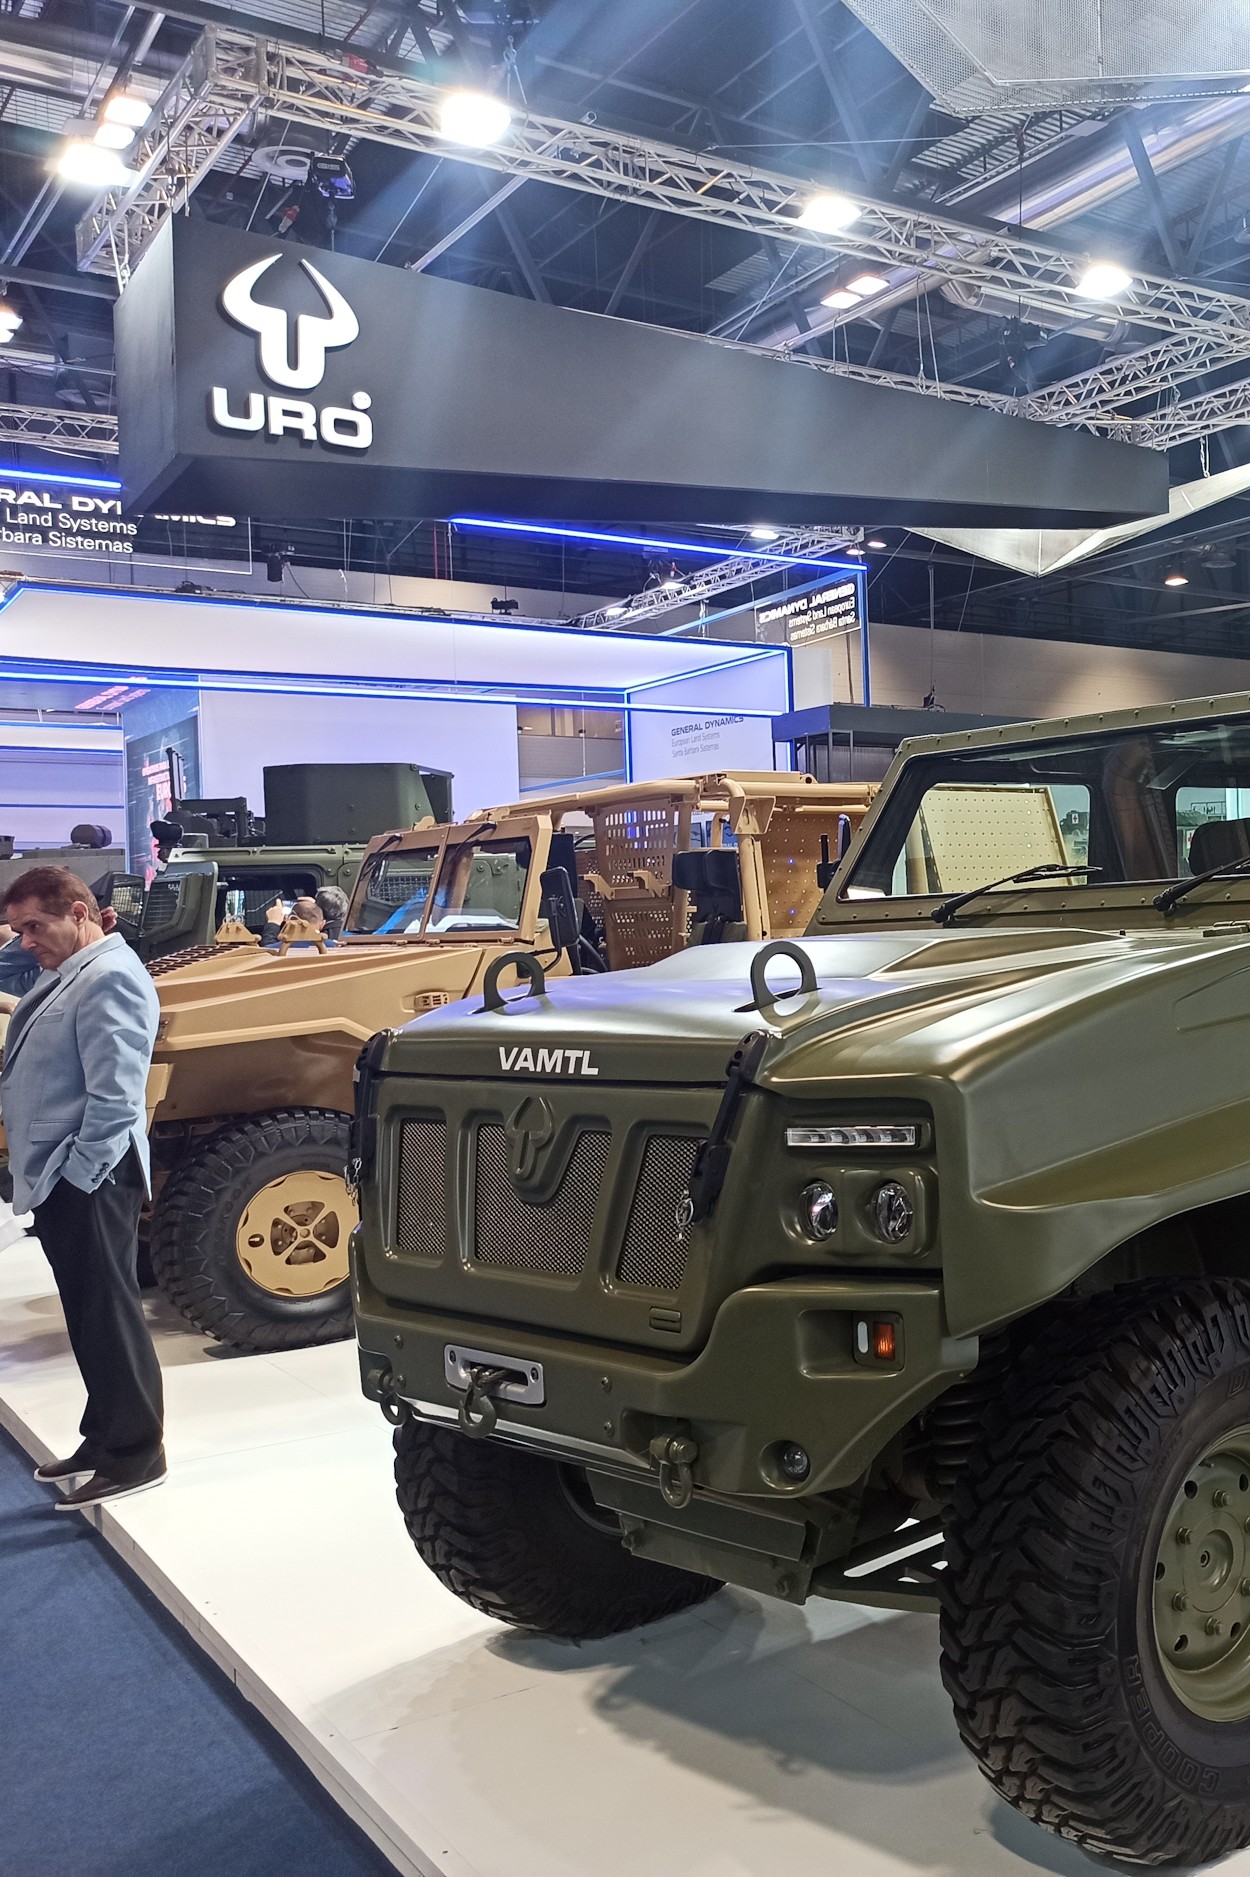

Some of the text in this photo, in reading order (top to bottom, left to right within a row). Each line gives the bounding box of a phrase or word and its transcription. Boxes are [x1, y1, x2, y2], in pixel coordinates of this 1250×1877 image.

[6, 507, 138, 535] Land Systems
[49, 531, 134, 554] Sistemas
[671, 715, 744, 737] GENERAL DYNAMICS
[499, 1046, 599, 1076] VAMTL
[1122, 1654, 1221, 1794] COOPER
